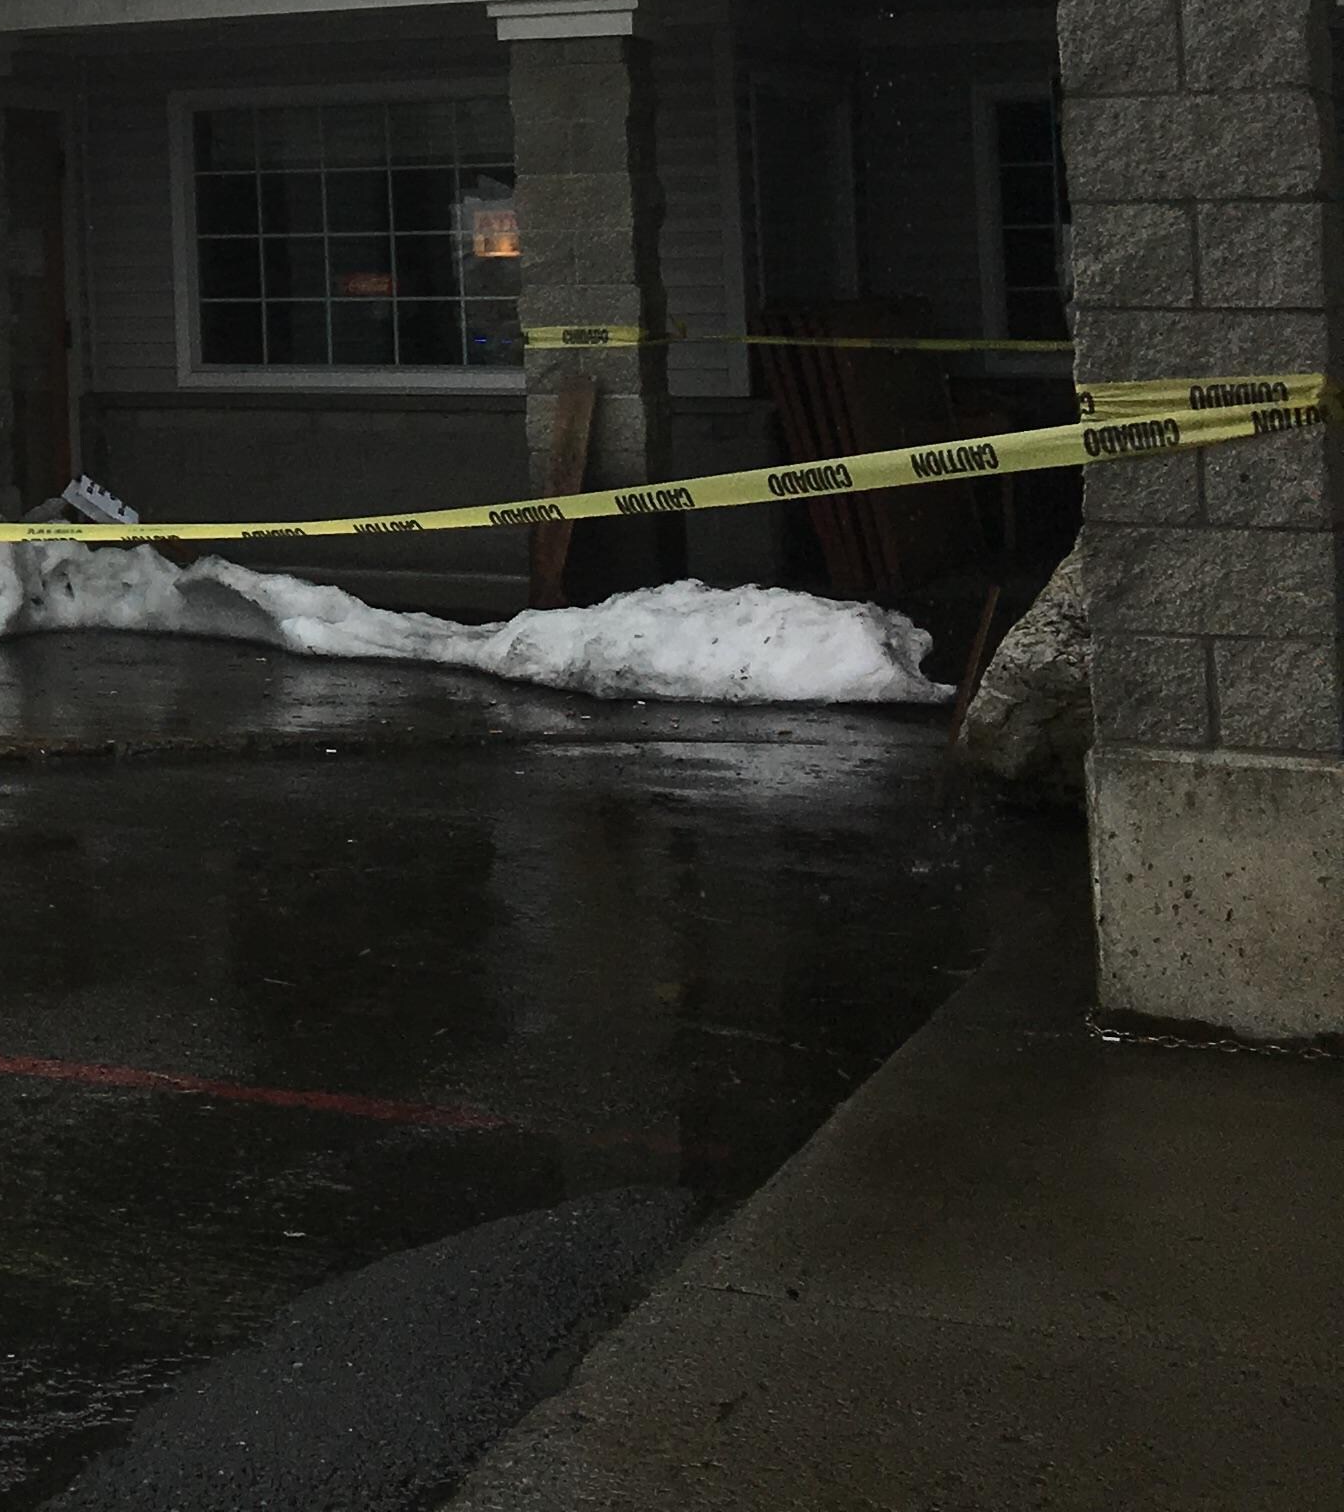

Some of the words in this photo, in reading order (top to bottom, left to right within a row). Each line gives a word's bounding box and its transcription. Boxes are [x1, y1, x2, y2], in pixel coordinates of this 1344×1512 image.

[1189, 381, 1289, 411] CUIDADO
[1083, 417, 1180, 458] CUIDADO
[911, 442, 999, 478] CAUTION
[767, 462, 853, 497] CUIDADO
[489, 502, 565, 528] CUIDADO
[615, 486, 696, 515] CAUTION
